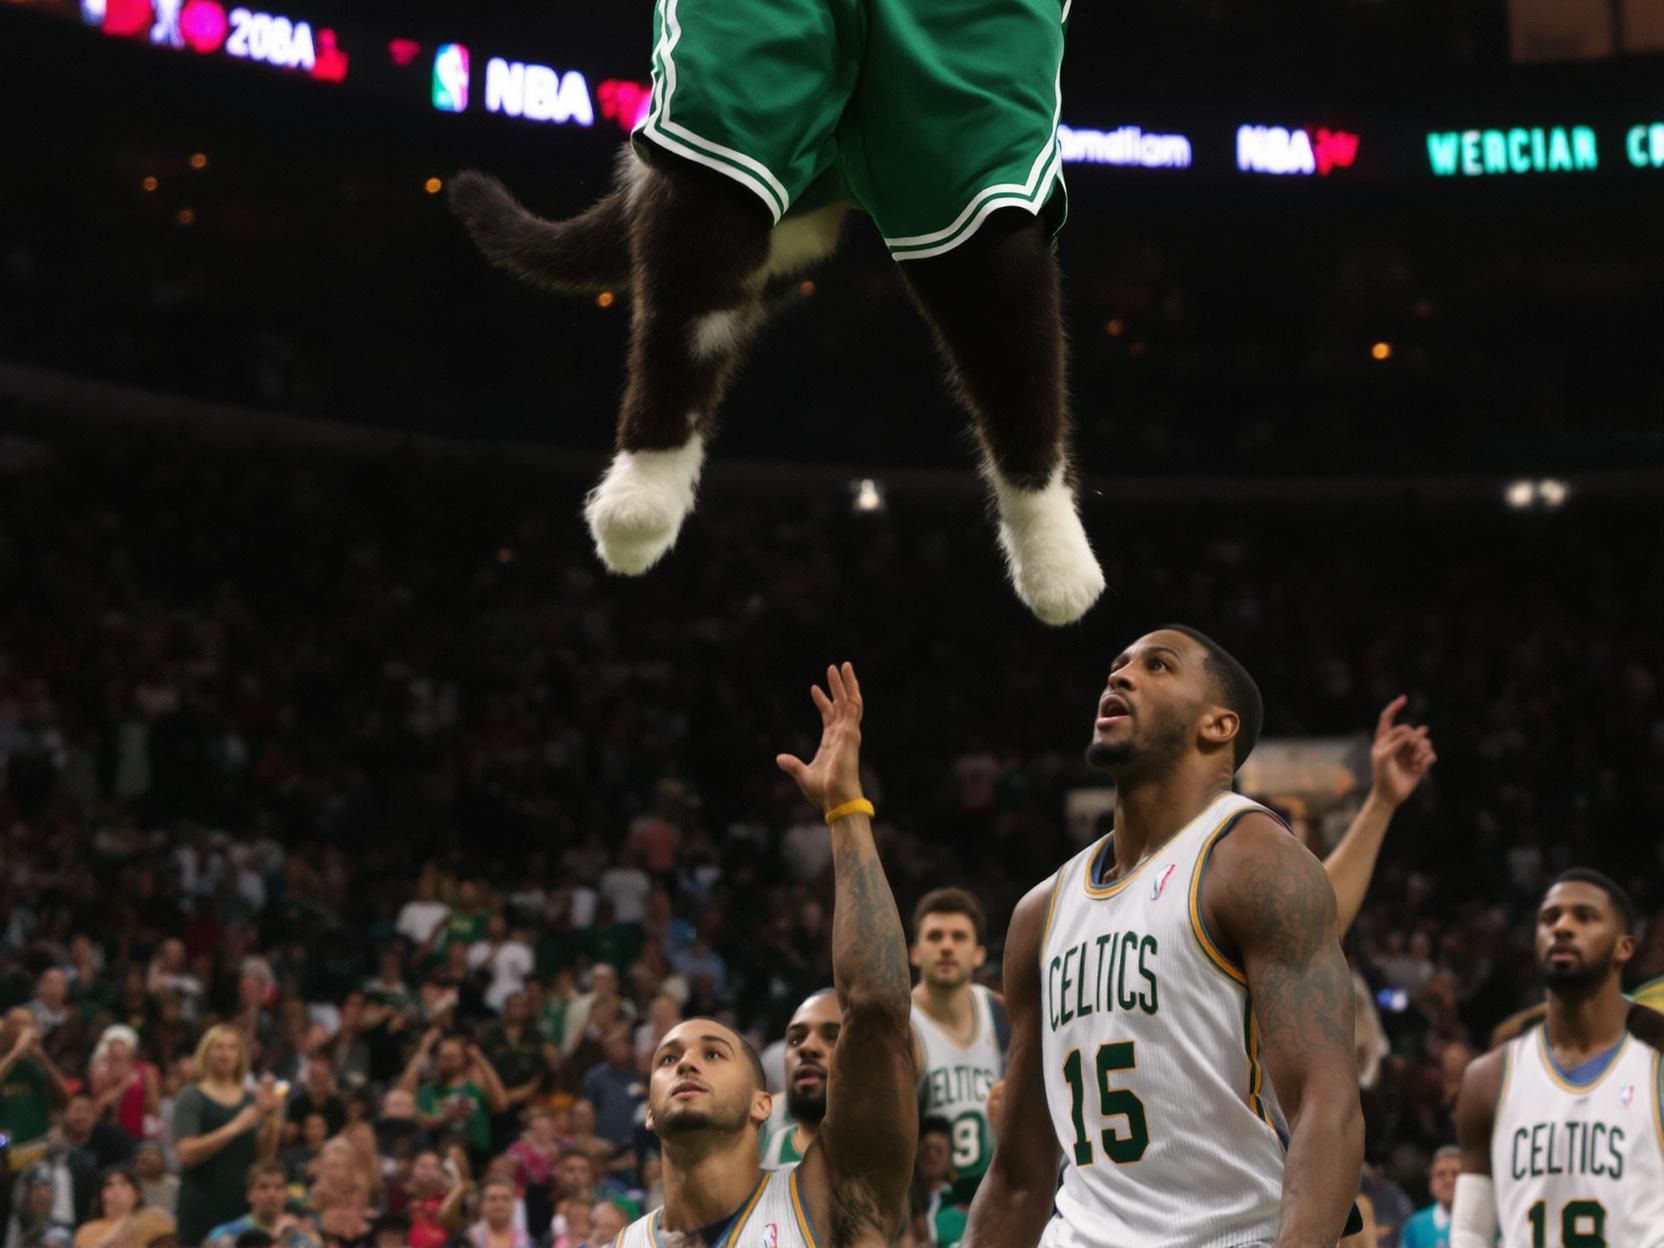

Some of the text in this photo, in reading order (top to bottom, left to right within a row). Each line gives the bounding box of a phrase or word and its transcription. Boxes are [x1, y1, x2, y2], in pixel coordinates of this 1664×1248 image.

[485, 57, 595, 128] NBA
[1047, 929, 1160, 1033] CELTICS
[1062, 1040, 1151, 1167] 15
[952, 1116, 982, 1169] 9
[1511, 1120, 1626, 1182] CELTICS
